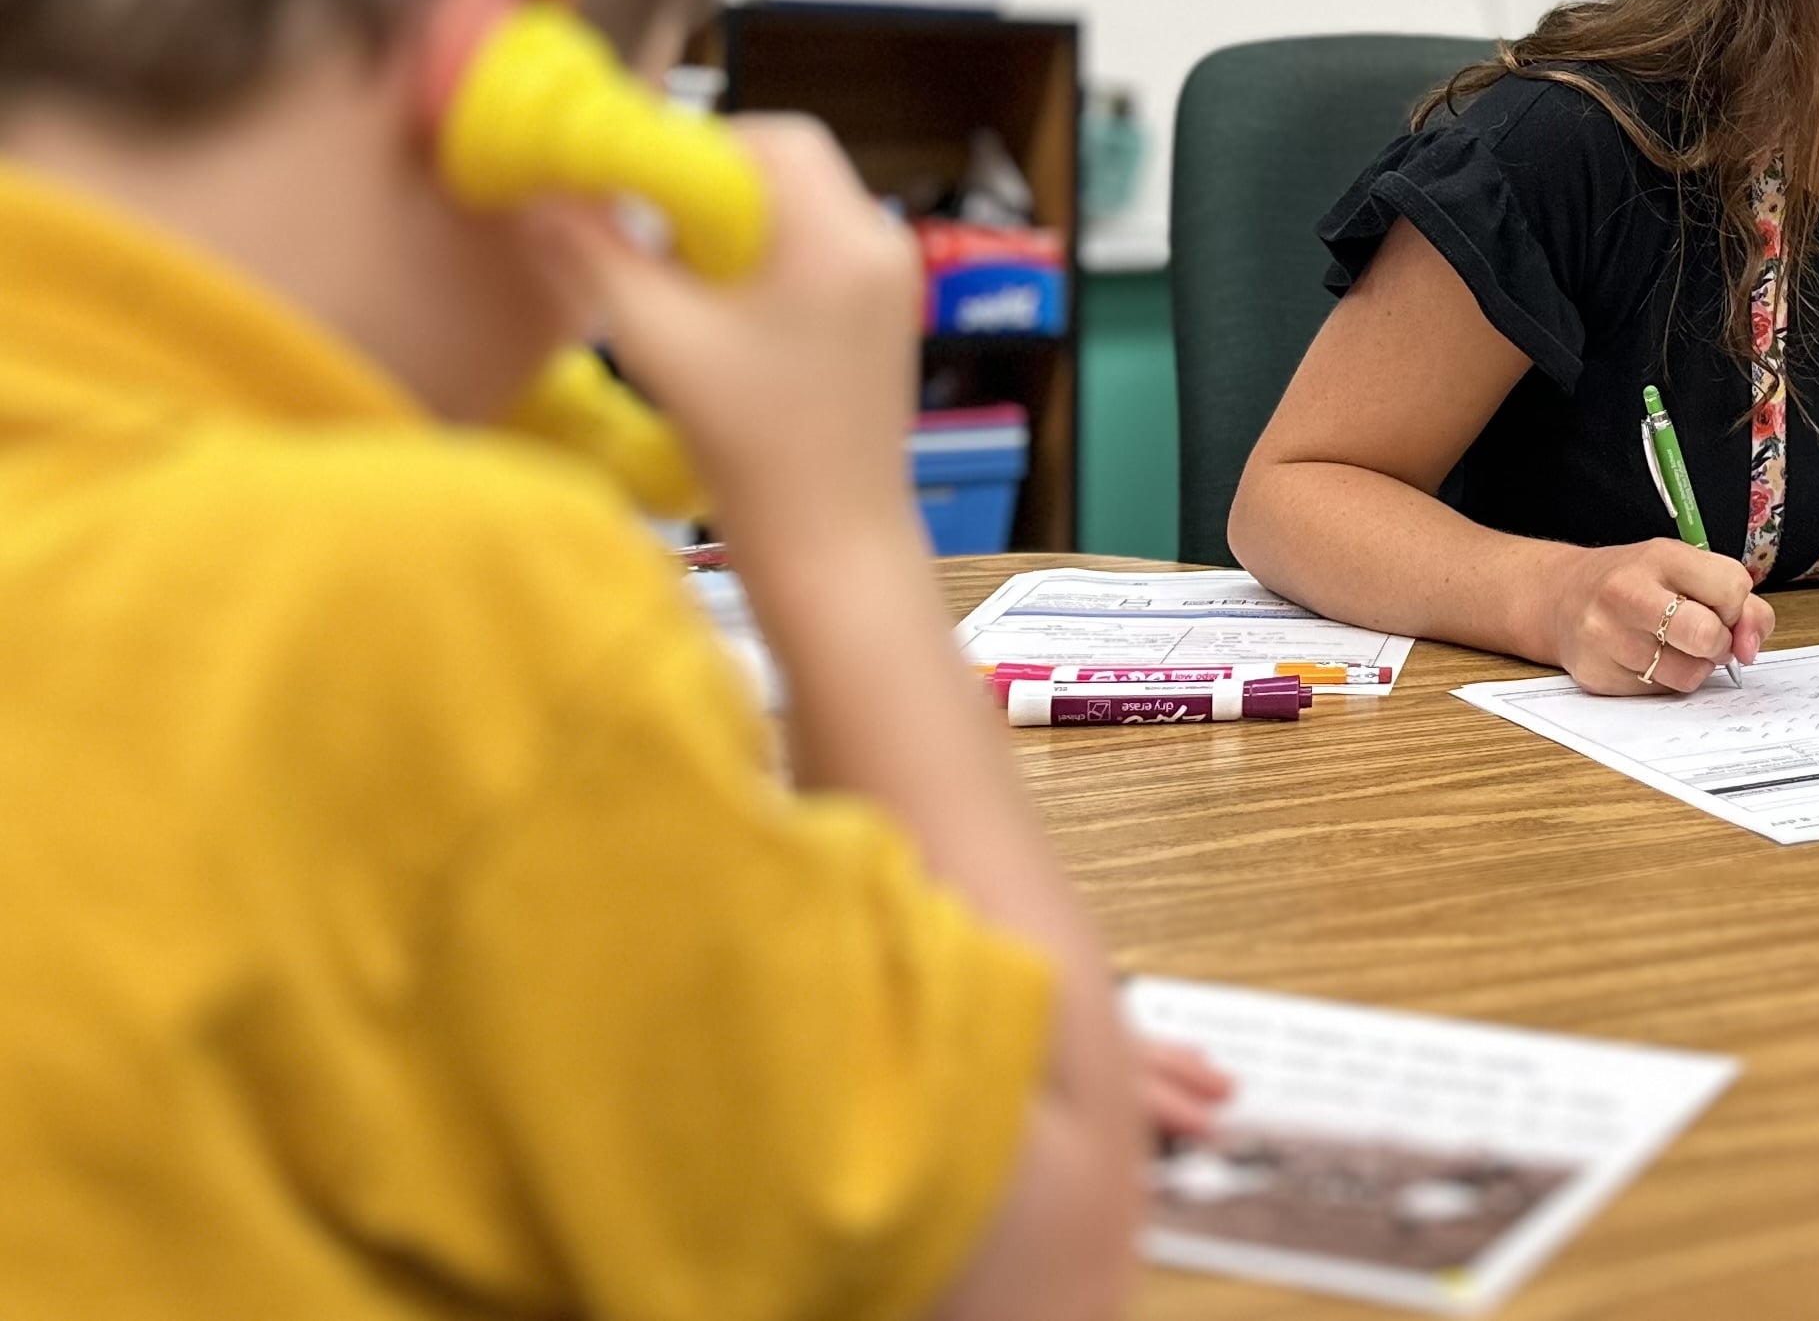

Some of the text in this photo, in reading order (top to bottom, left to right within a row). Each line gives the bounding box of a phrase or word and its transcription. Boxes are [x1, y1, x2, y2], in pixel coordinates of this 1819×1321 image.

[1122, 699, 1174, 712] dry erase
[1058, 713, 1086, 722] chisel
